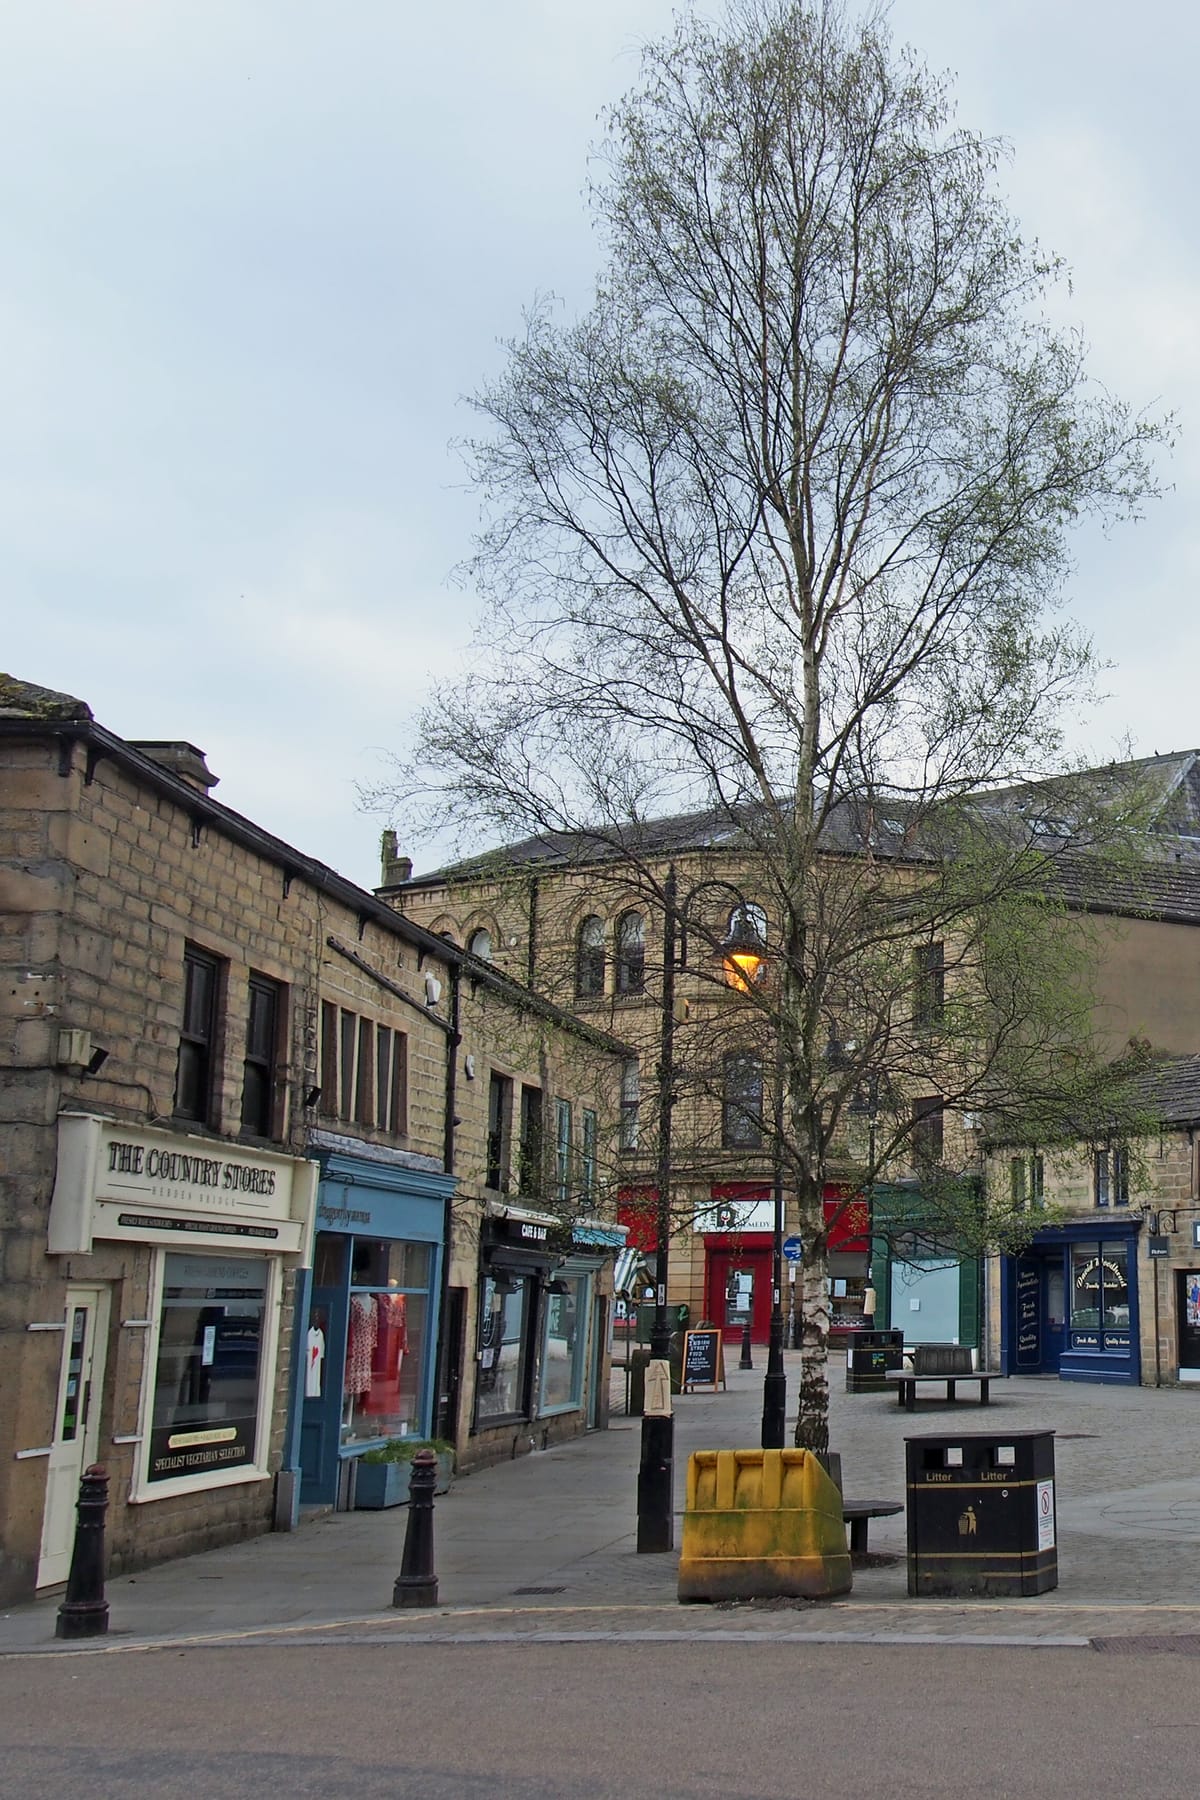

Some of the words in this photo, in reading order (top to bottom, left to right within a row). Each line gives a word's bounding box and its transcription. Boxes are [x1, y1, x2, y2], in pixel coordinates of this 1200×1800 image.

[109, 1141, 145, 1174] THE
[148, 1148, 223, 1188] COUNTRY
[223, 1162, 276, 1196] STORES
[521, 1223, 534, 1238] CAFE
[154, 1455, 186, 1472] SPECIALIST
[186, 1450, 219, 1466] VEGETARIAN
[218, 1445, 246, 1460] SELECTION
[926, 1472, 953, 1482] Litter
[981, 1471, 1008, 1481] Litter
